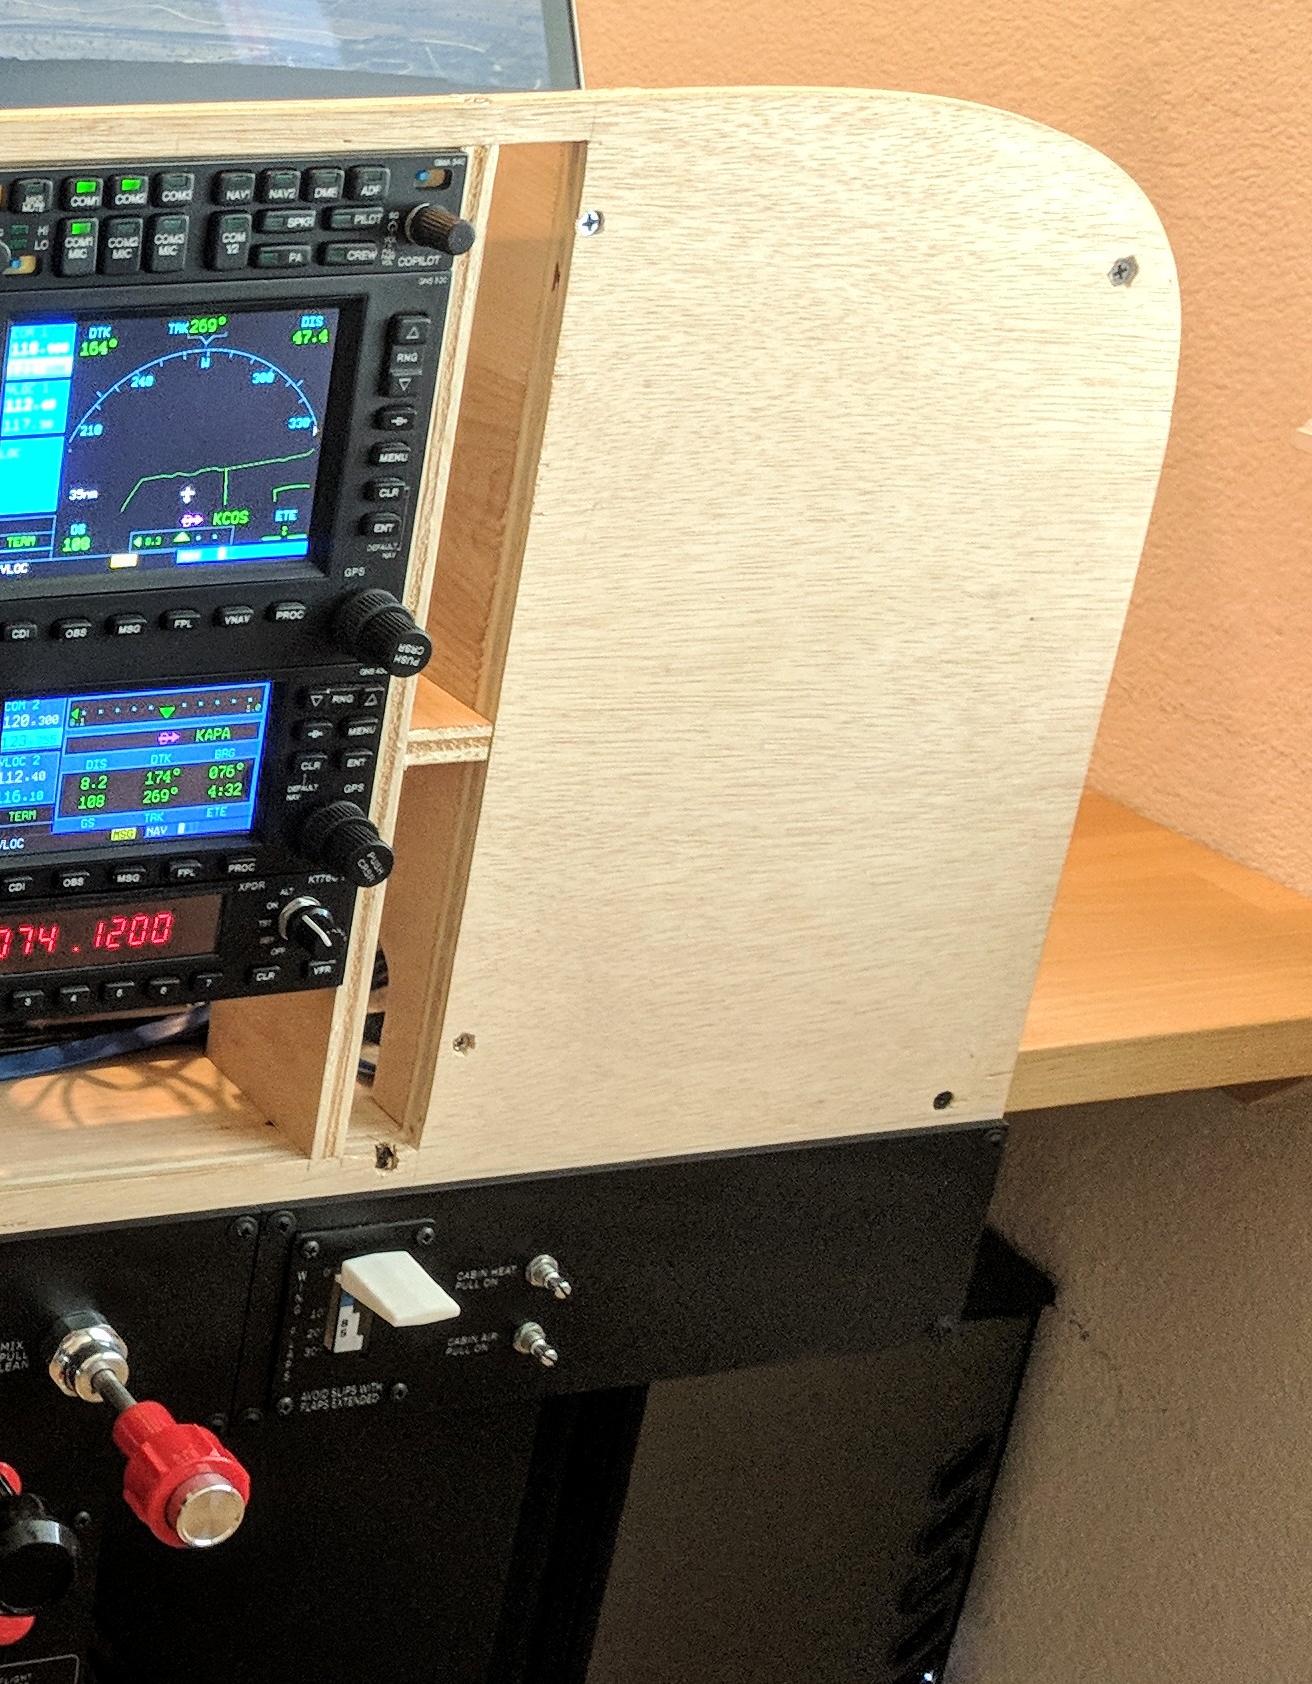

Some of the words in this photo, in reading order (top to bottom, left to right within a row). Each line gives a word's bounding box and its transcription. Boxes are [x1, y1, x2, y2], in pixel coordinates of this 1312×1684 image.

[268, 188, 297, 200] NAV2
[397, 255, 442, 268] COPILOT
[300, 315, 325, 329] DIS
[291, 328, 330, 346] 47.4
[396, 352, 418, 363] RNG
[379, 452, 409, 464] MENU
[379, 487, 400, 499] CLR
[211, 508, 251, 527] KCOS
[373, 522, 395, 534] ENT
[344, 566, 366, 579] GPS
[275, 609, 306, 621] PROC
[173, 618, 193, 631] FPL
[11, 629, 30, 639] CDI
[65, 628, 87, 639] OBS
[195, 727, 231, 742] KAPA
[0, 756, 26, 767] VLOC
[80, 775, 108, 790] 8.2
[207, 782, 243, 799] 4:32
[238, 881, 266, 891] XPDR
[0, 1340, 24, 1353] MIX
